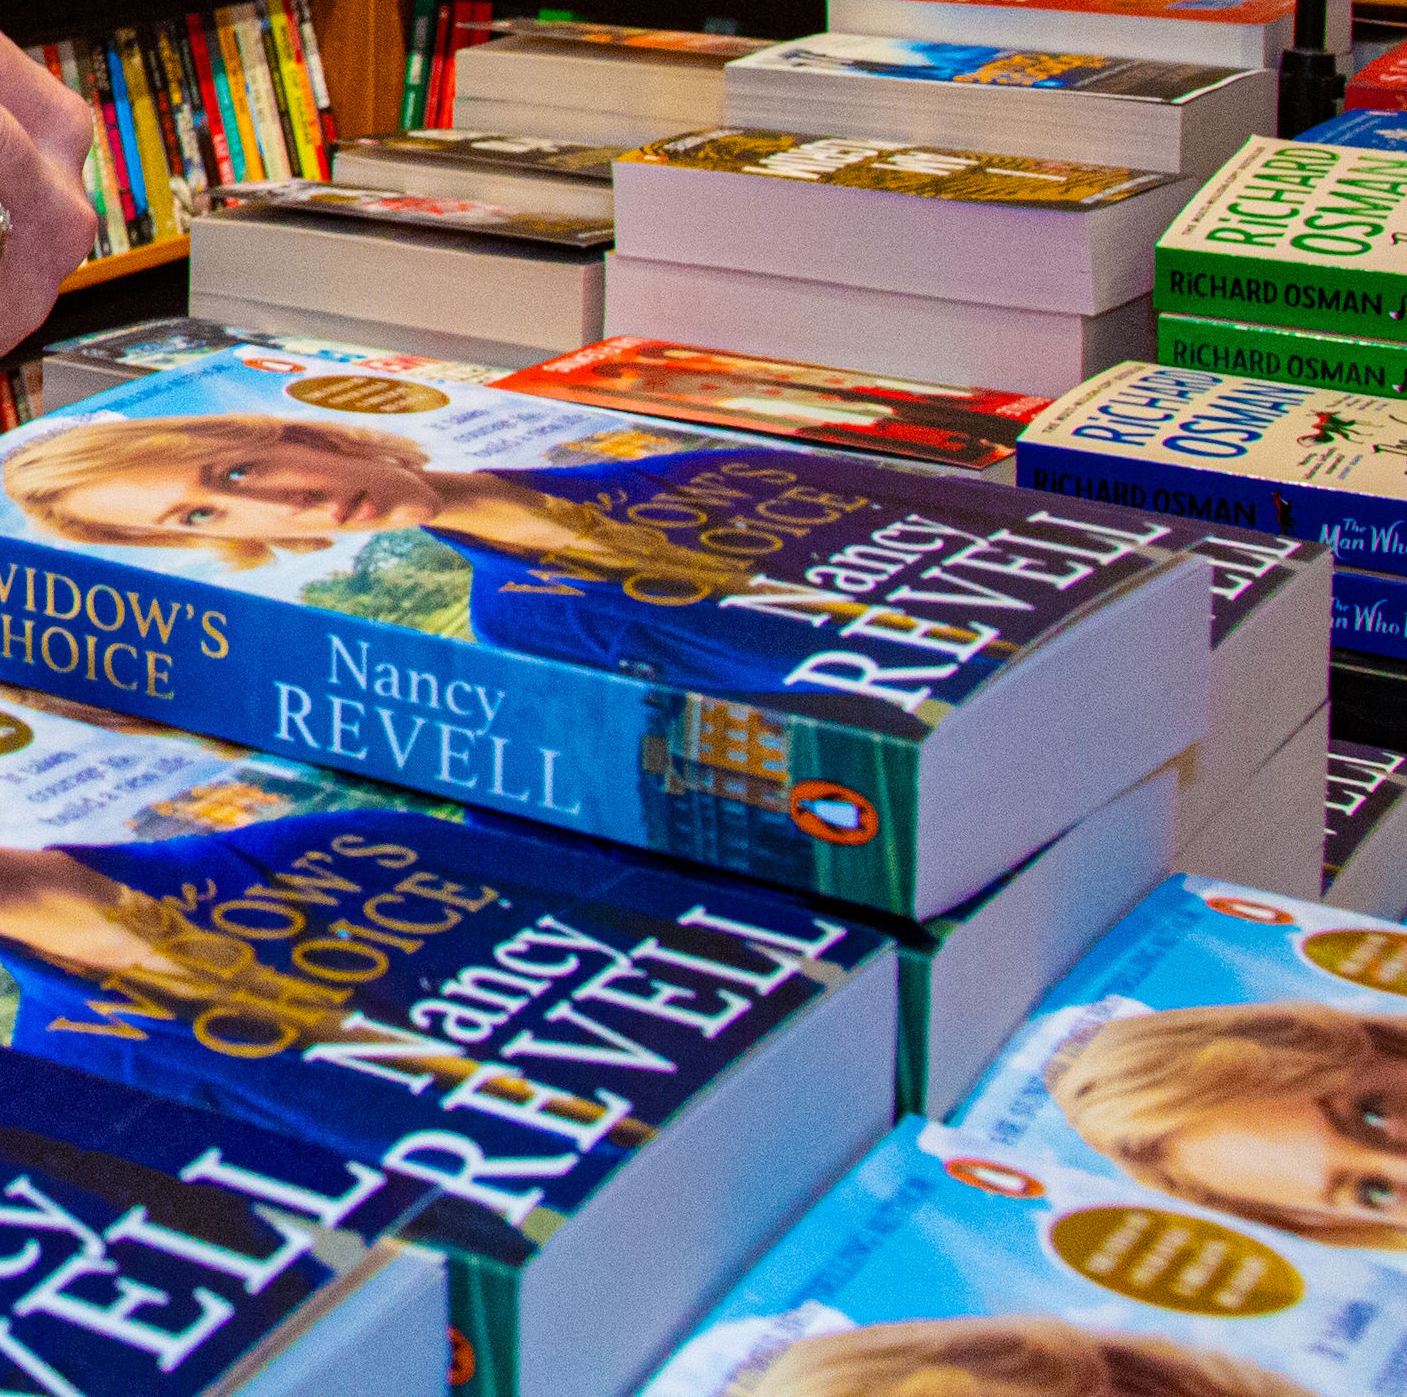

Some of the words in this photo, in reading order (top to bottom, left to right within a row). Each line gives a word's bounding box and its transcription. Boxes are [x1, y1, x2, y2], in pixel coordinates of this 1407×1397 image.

[1290, 155, 1407, 257] OSMAN
[1285, 283, 1383, 315] OSMAN
[1162, 383, 1314, 459] OSMAN
[1288, 354, 1384, 388] OSMAN
[1153, 488, 1256, 527] OSMAN
[721, 514, 982, 626] Nancy
[784, 509, 1173, 714] REVELL
[1355, 600, 1399, 635] Who
[325, 633, 506, 737] Nancy
[271, 681, 584, 818] REVELL
[398, 911, 867, 1218] REVELL
